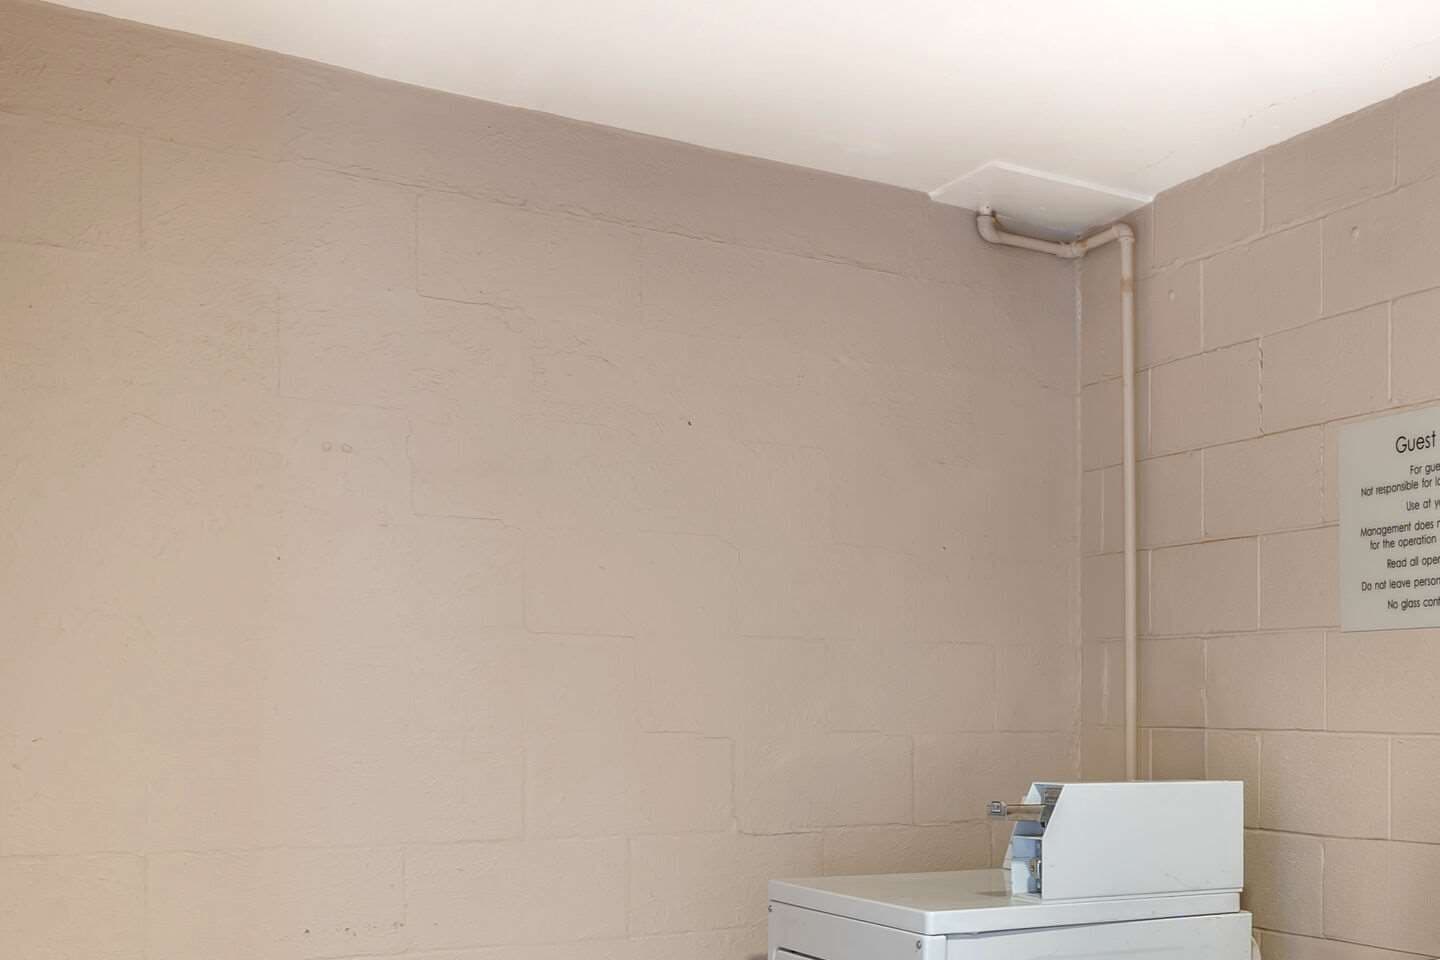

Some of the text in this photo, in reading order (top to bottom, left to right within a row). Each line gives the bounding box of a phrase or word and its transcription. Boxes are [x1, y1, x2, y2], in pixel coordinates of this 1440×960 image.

[1395, 430, 1436, 453] Guest
[1410, 464, 1422, 475] For
[1361, 487, 1373, 497] Not
[1376, 480, 1418, 494] responsible
[1422, 478, 1432, 489] for
[1406, 501, 1419, 511] Use
[1423, 499, 1431, 509] at
[1360, 523, 1411, 537] Management
[1415, 520, 1434, 532] does
[1370, 540, 1380, 550] for
[1383, 538, 1395, 548] the
[1398, 534, 1437, 547] operation
[1387, 558, 1407, 569] Read
[1410, 556, 1419, 566] all
[1362, 582, 1371, 591] Do
[1375, 581, 1386, 590] not
[1390, 579, 1411, 589] leave
[1388, 600, 1398, 609] No
[1401, 598, 1420, 611] glass
